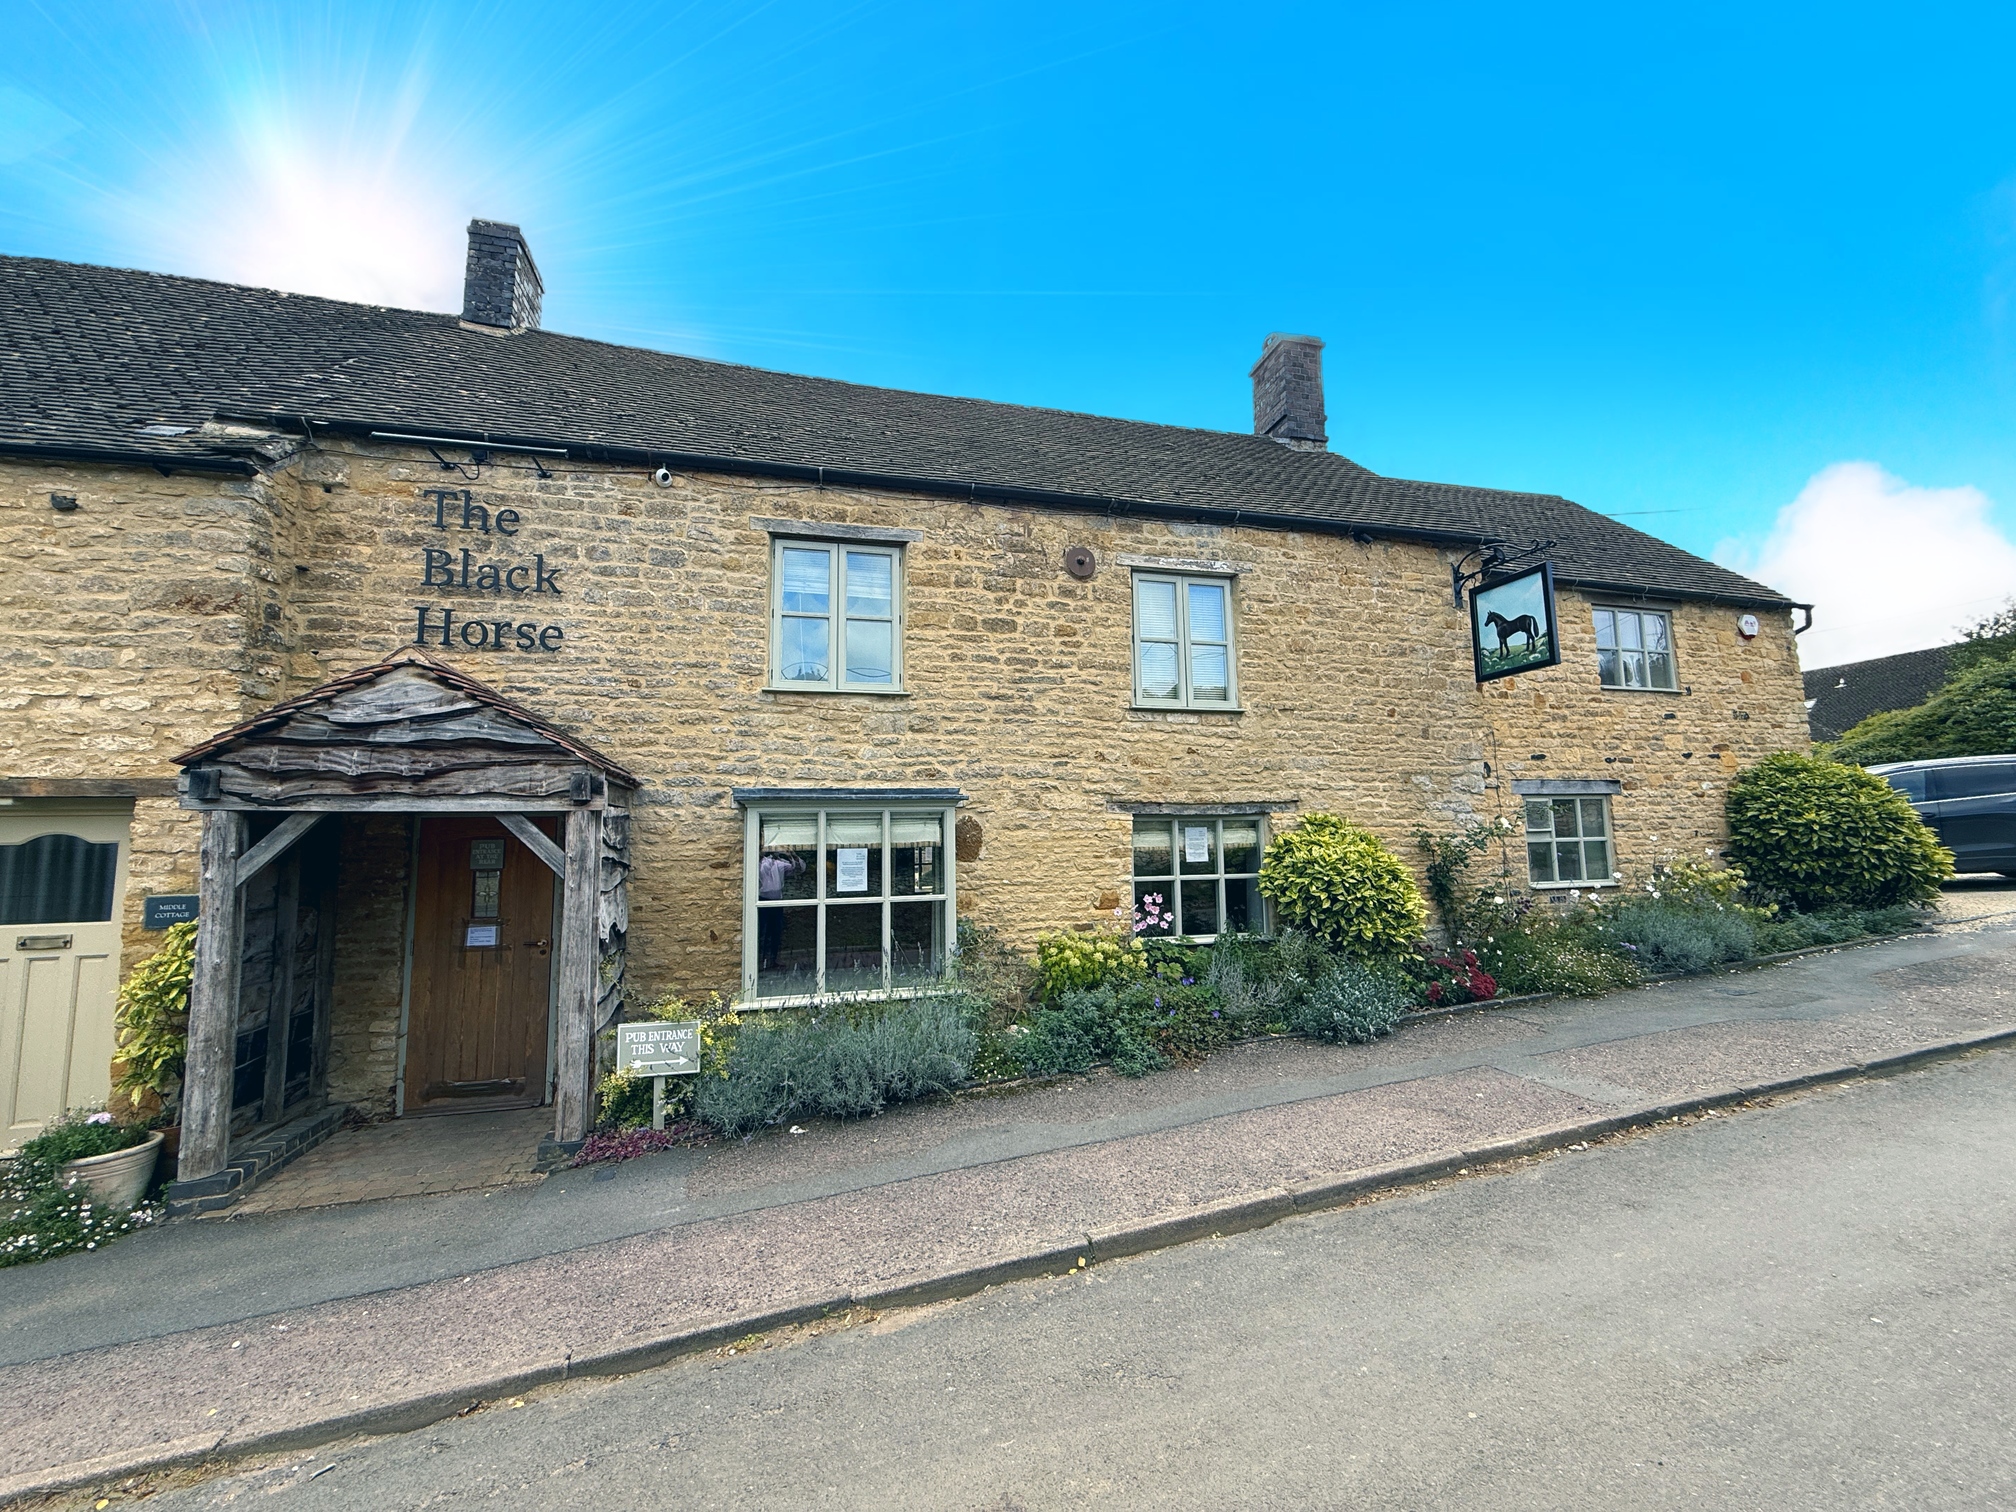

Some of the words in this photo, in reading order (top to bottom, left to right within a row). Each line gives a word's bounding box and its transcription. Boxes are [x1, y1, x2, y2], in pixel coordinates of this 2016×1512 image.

[423, 489, 520, 536] The
[420, 547, 563, 594] Black
[412, 606, 564, 652] Horse
[625, 1032, 646, 1043] PUB
[648, 1029, 693, 1041] ENTRANCE
[631, 1043, 654, 1055] THIS
[659, 1041, 685, 1054] WAY
